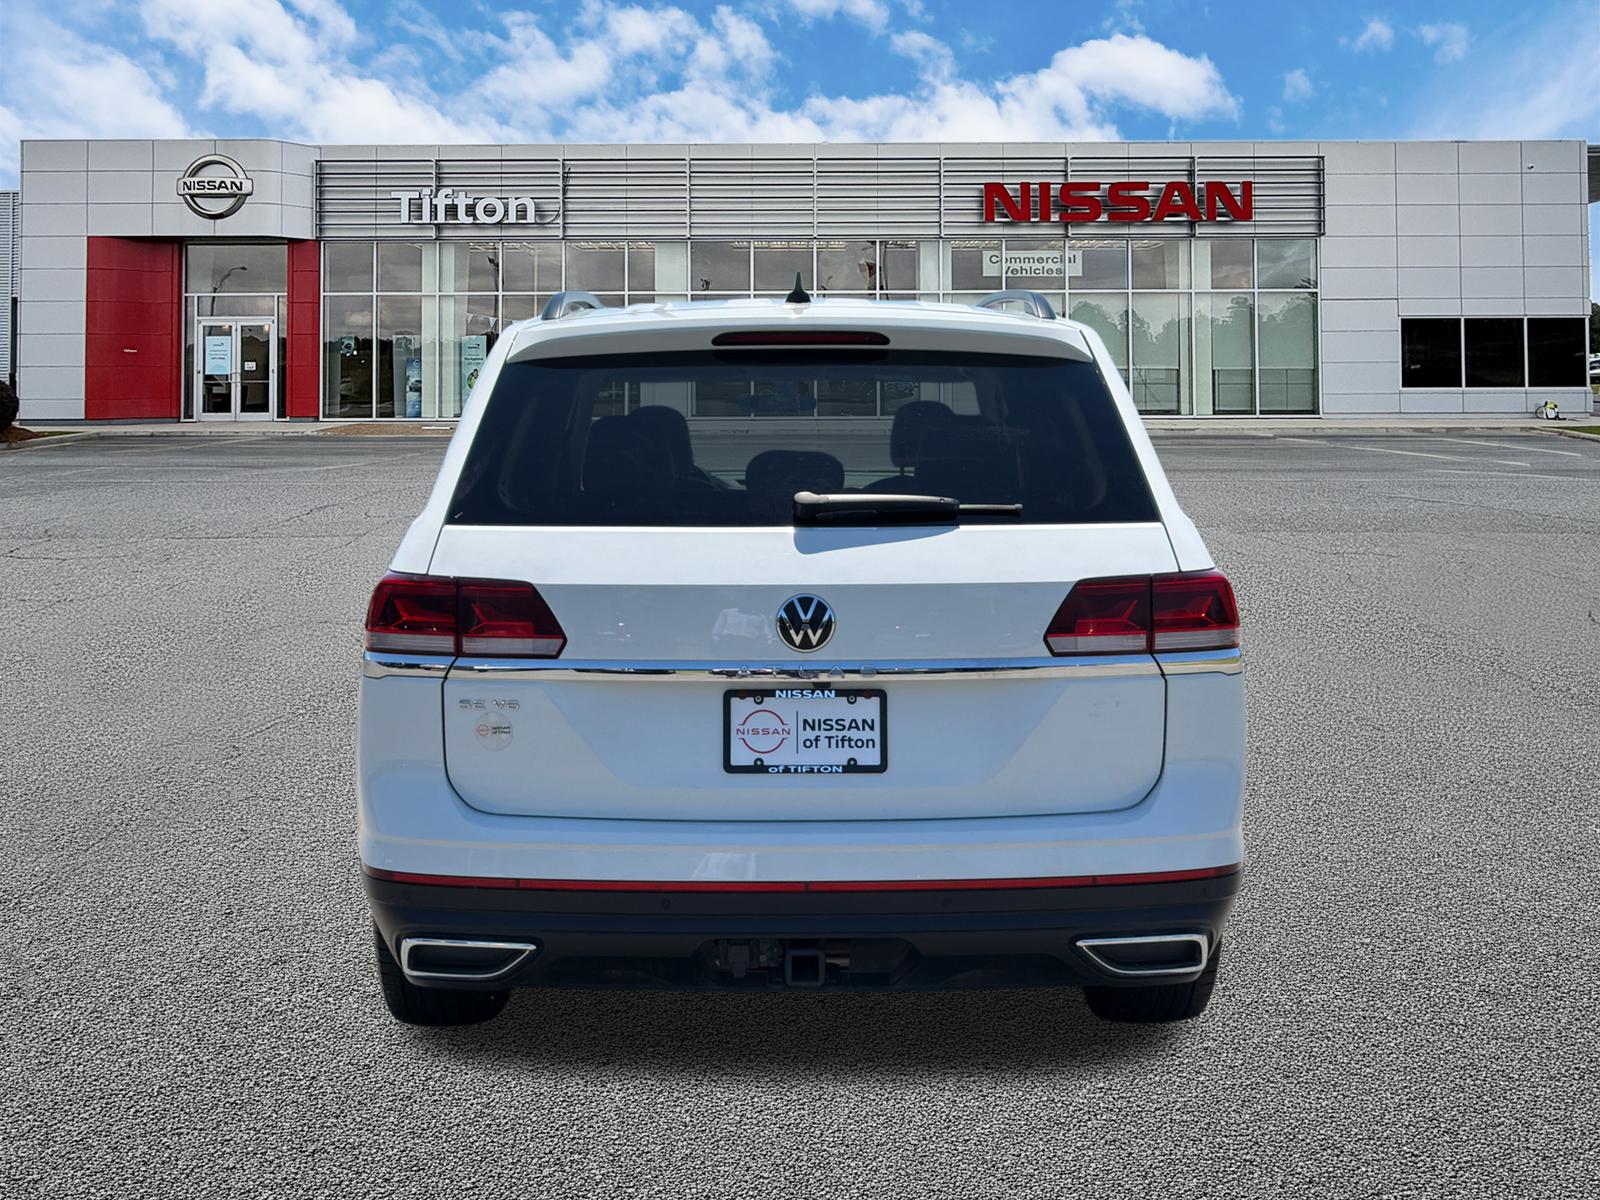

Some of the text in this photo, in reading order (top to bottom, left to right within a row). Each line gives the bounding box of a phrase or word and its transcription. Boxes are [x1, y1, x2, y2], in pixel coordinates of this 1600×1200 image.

[182, 180, 243, 193] NISSAN
[390, 188, 536, 225] Tifton
[983, 181, 1254, 222] NISSAN
[775, 690, 836, 699] NISSAN
[736, 727, 791, 736] NISSAN
[802, 718, 875, 732] NISSAN
[802, 736, 876, 749] of Tifton
[768, 765, 843, 773] of TIFTON
